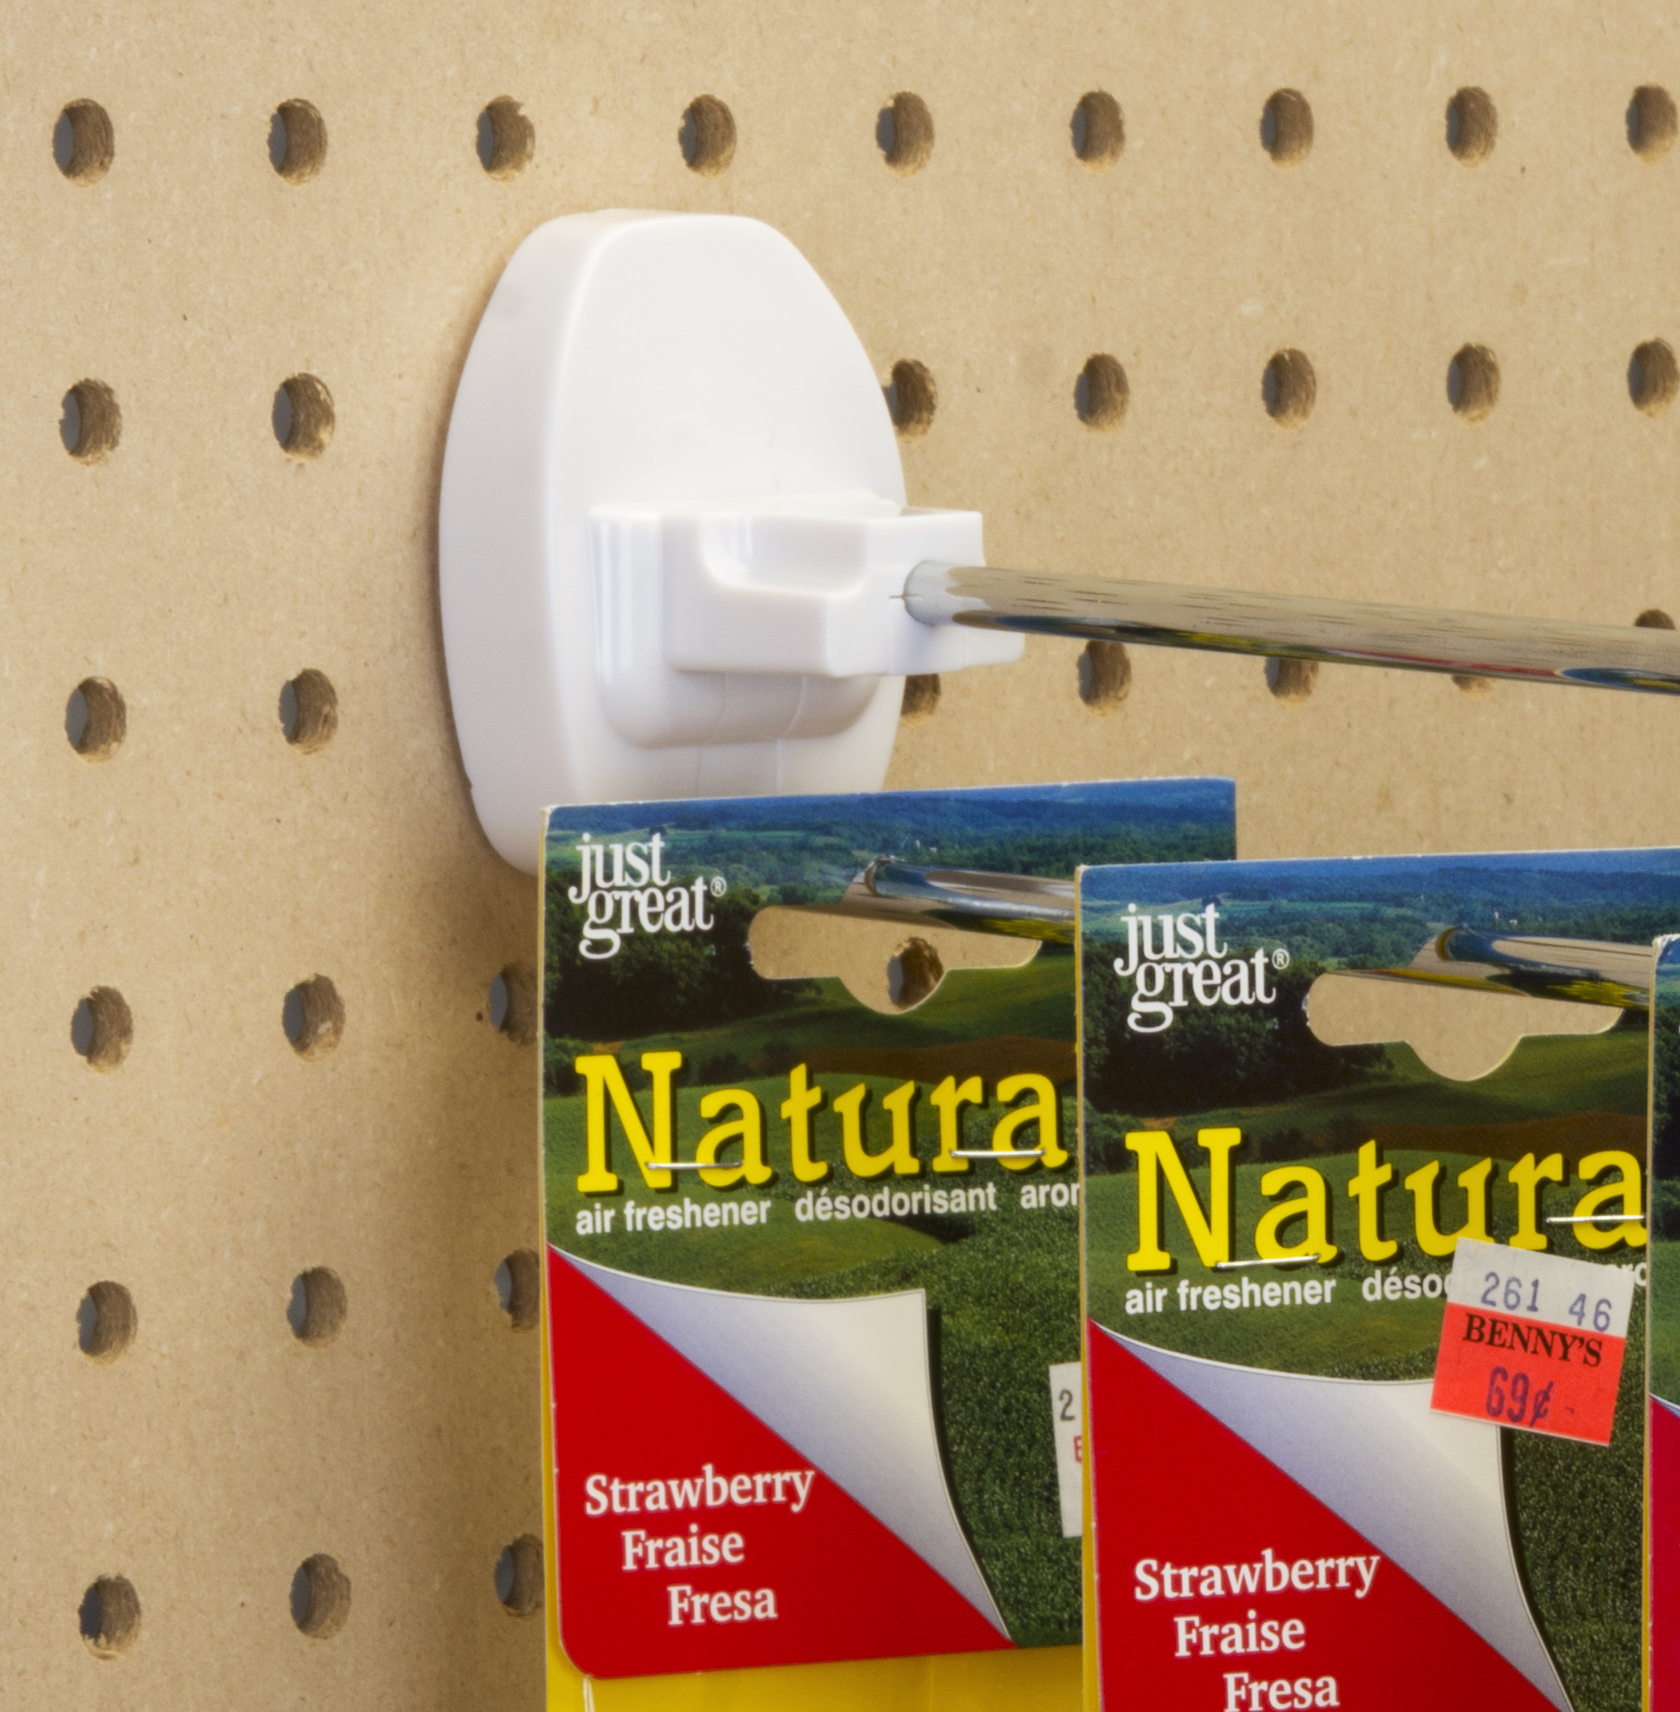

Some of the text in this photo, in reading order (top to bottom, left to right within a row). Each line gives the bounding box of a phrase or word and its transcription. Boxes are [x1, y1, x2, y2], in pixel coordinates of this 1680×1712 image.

[568, 832, 671, 904] just
[1113, 903, 1228, 977] just
[576, 1204, 615, 1235] air
[624, 1196, 771, 1233] freshener
[795, 1181, 997, 1222] désodorisant
[1124, 1282, 1165, 1315] air
[1176, 1275, 1337, 1312] freshener
[1480, 1271, 1612, 1332] 261 46
[1462, 1313, 1603, 1367] BENNY'S
[1485, 1366, 1554, 1429] 69¢
[585, 1463, 815, 1516] Strawberry
[621, 1522, 745, 1571] Fraise
[1134, 1547, 1380, 1601] Strawberry
[667, 1584, 778, 1626] Fresa
[1173, 1609, 1306, 1657] Fraise
[1223, 1671, 1340, 1712] Fresa
